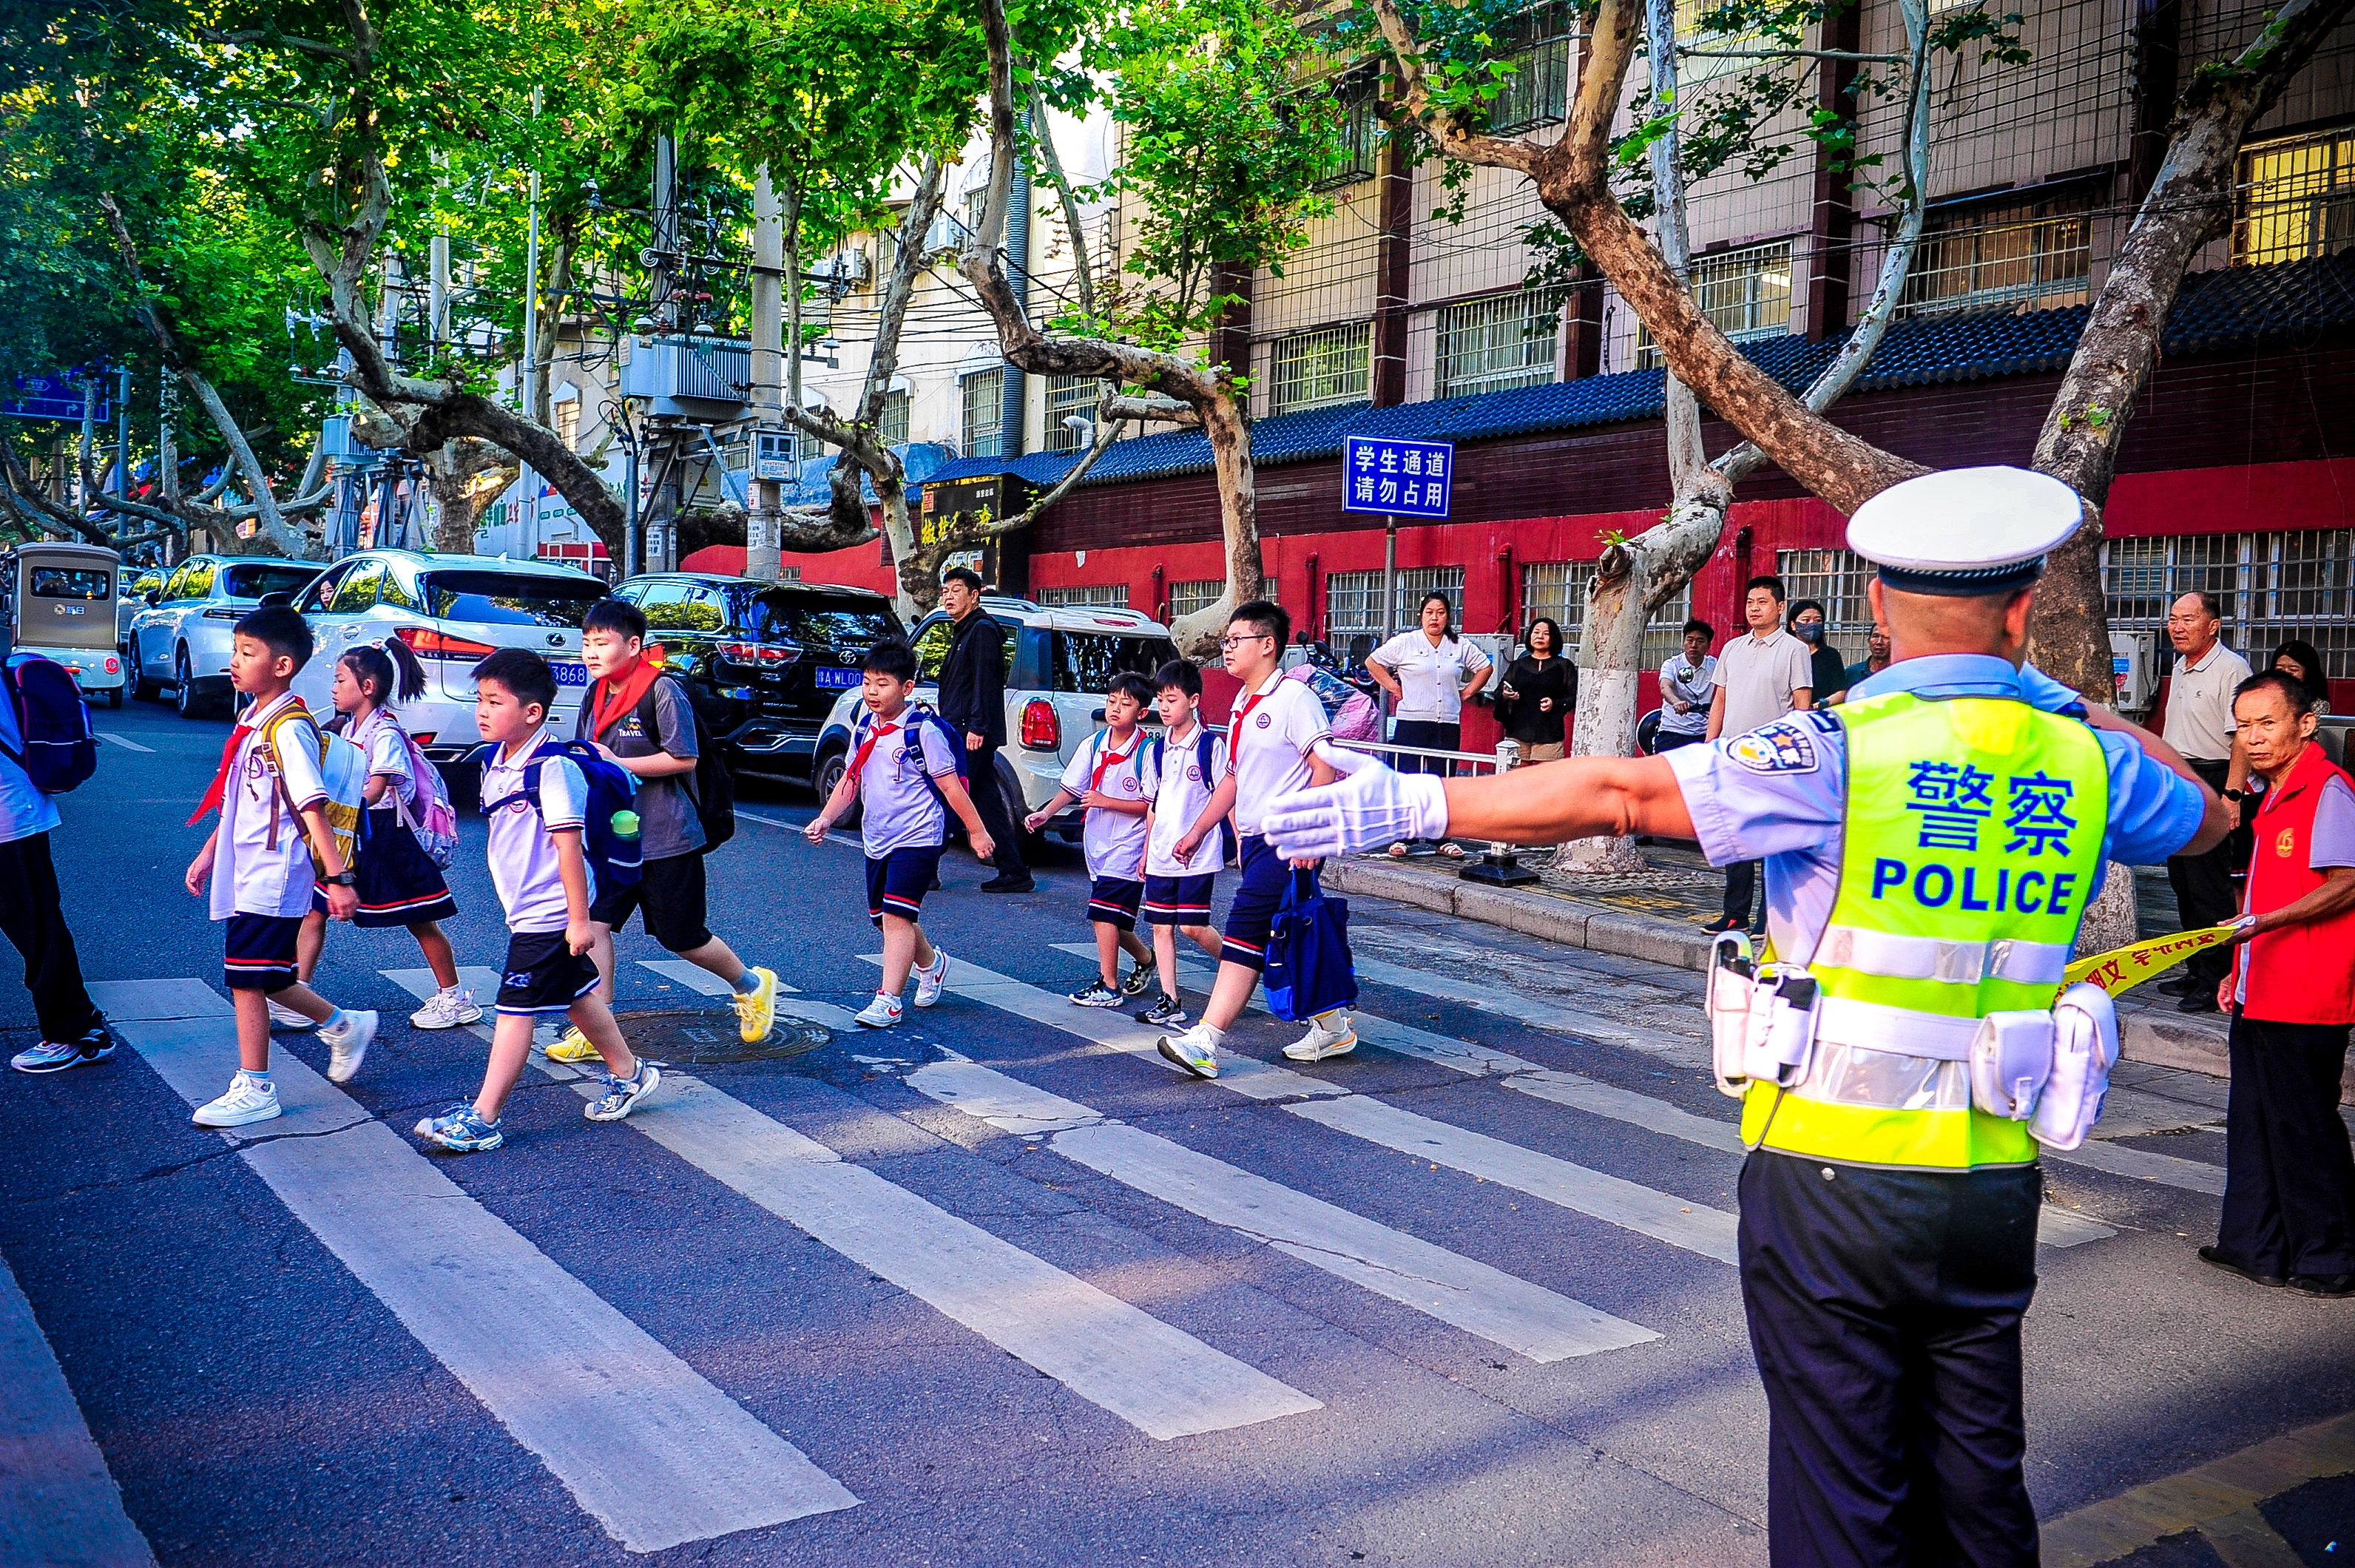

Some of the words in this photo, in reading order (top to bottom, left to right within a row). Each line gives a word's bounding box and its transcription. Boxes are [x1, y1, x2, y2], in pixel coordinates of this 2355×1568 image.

[1355, 445, 1445, 477] 学生通道
[1354, 476, 1443, 507] 请勿占用
[618, 729, 643, 737] TRAVEL
[1905, 760, 2078, 858] 警察
[1871, 858, 2078, 916] POLICE
